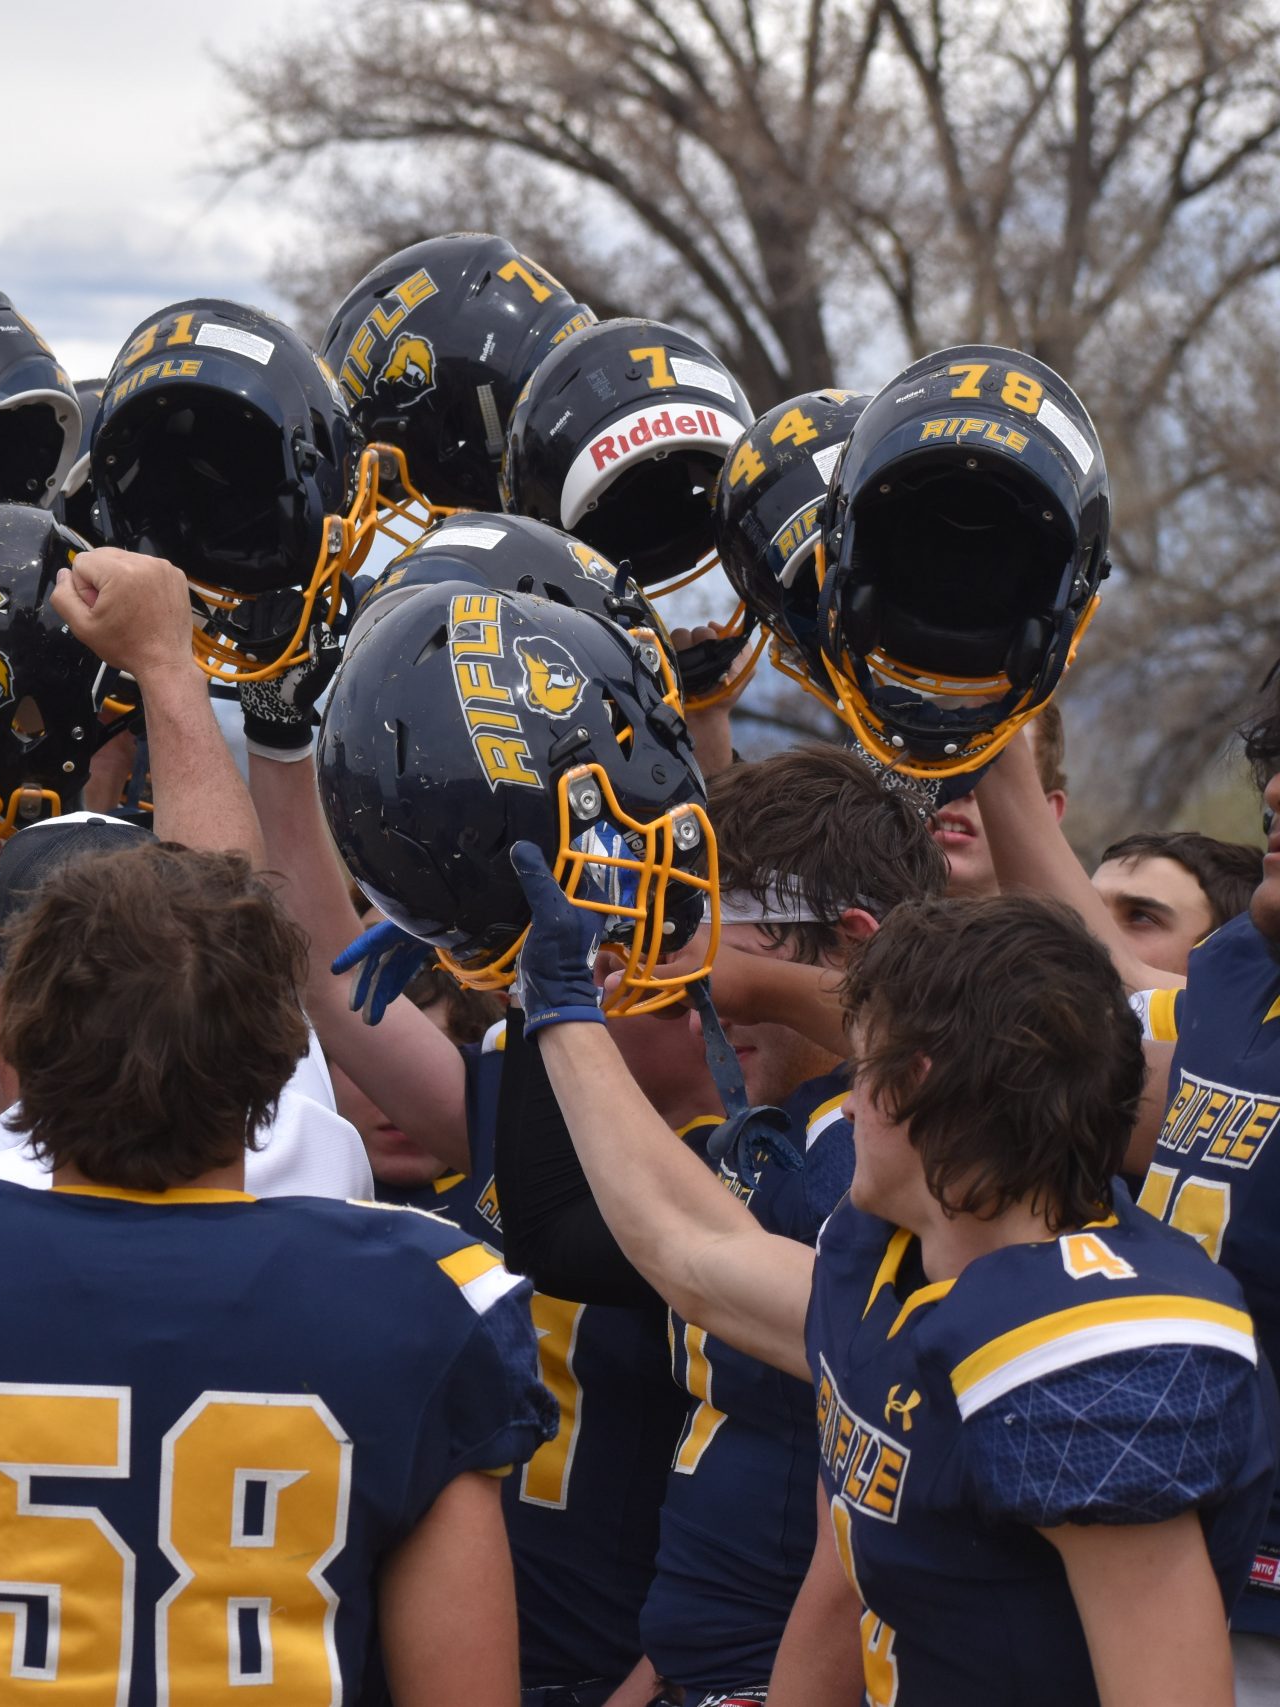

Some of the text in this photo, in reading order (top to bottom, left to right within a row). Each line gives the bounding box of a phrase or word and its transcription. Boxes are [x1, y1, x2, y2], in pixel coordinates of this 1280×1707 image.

[338, 267, 440, 404] IFLE
[947, 364, 1043, 416] 78
[589, 410, 722, 471] Riddell
[728, 407, 819, 489] 44
[919, 417, 1030, 454] RIFLE
[775, 506, 819, 562] RIF
[449, 594, 545, 794] RIFLE
[1157, 1067, 1280, 1170] RIFLE
[1058, 1232, 1139, 1281] 4
[816, 1351, 912, 1525] RIFLE
